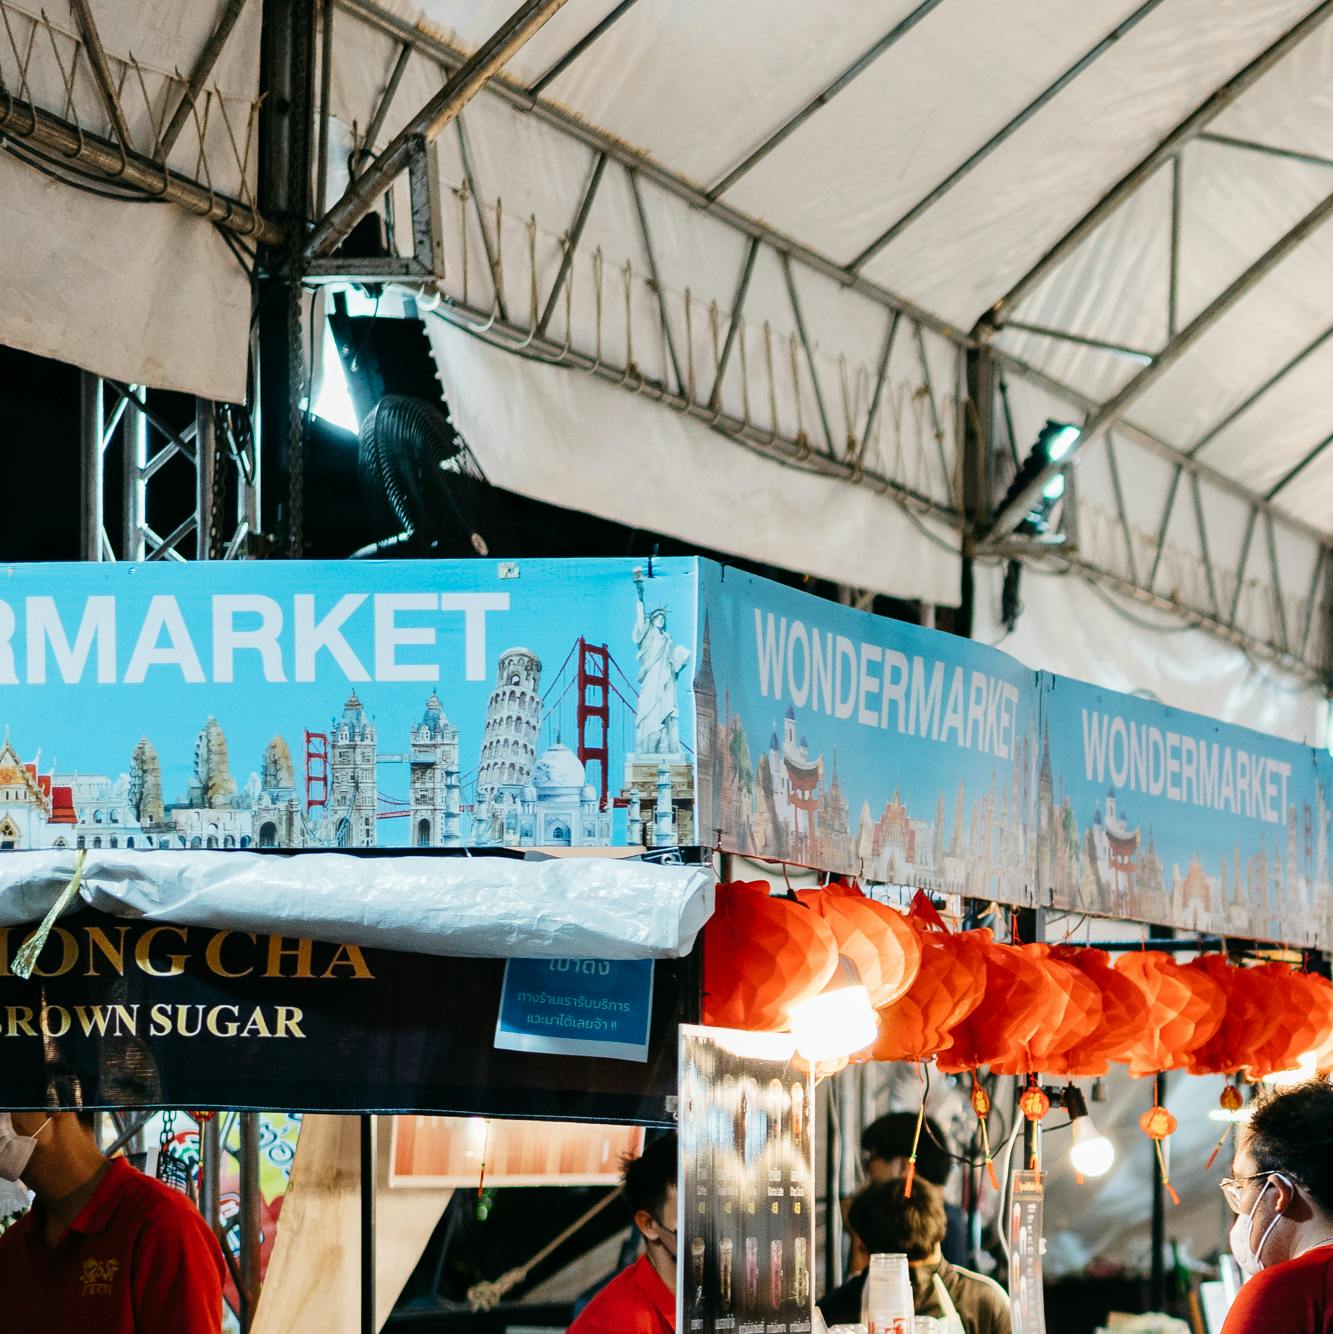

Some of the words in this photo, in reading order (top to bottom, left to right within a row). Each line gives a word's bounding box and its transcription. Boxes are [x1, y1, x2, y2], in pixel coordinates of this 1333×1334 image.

[0, 592, 510, 685] MARKET
[755, 608, 1019, 761] WONDERMARKET
[1082, 708, 1291, 825] WONDERMARKET
[205, 926, 376, 980] CHA
[0, 1004, 140, 1038] ROWN
[150, 1003, 306, 1039] SUGAR
